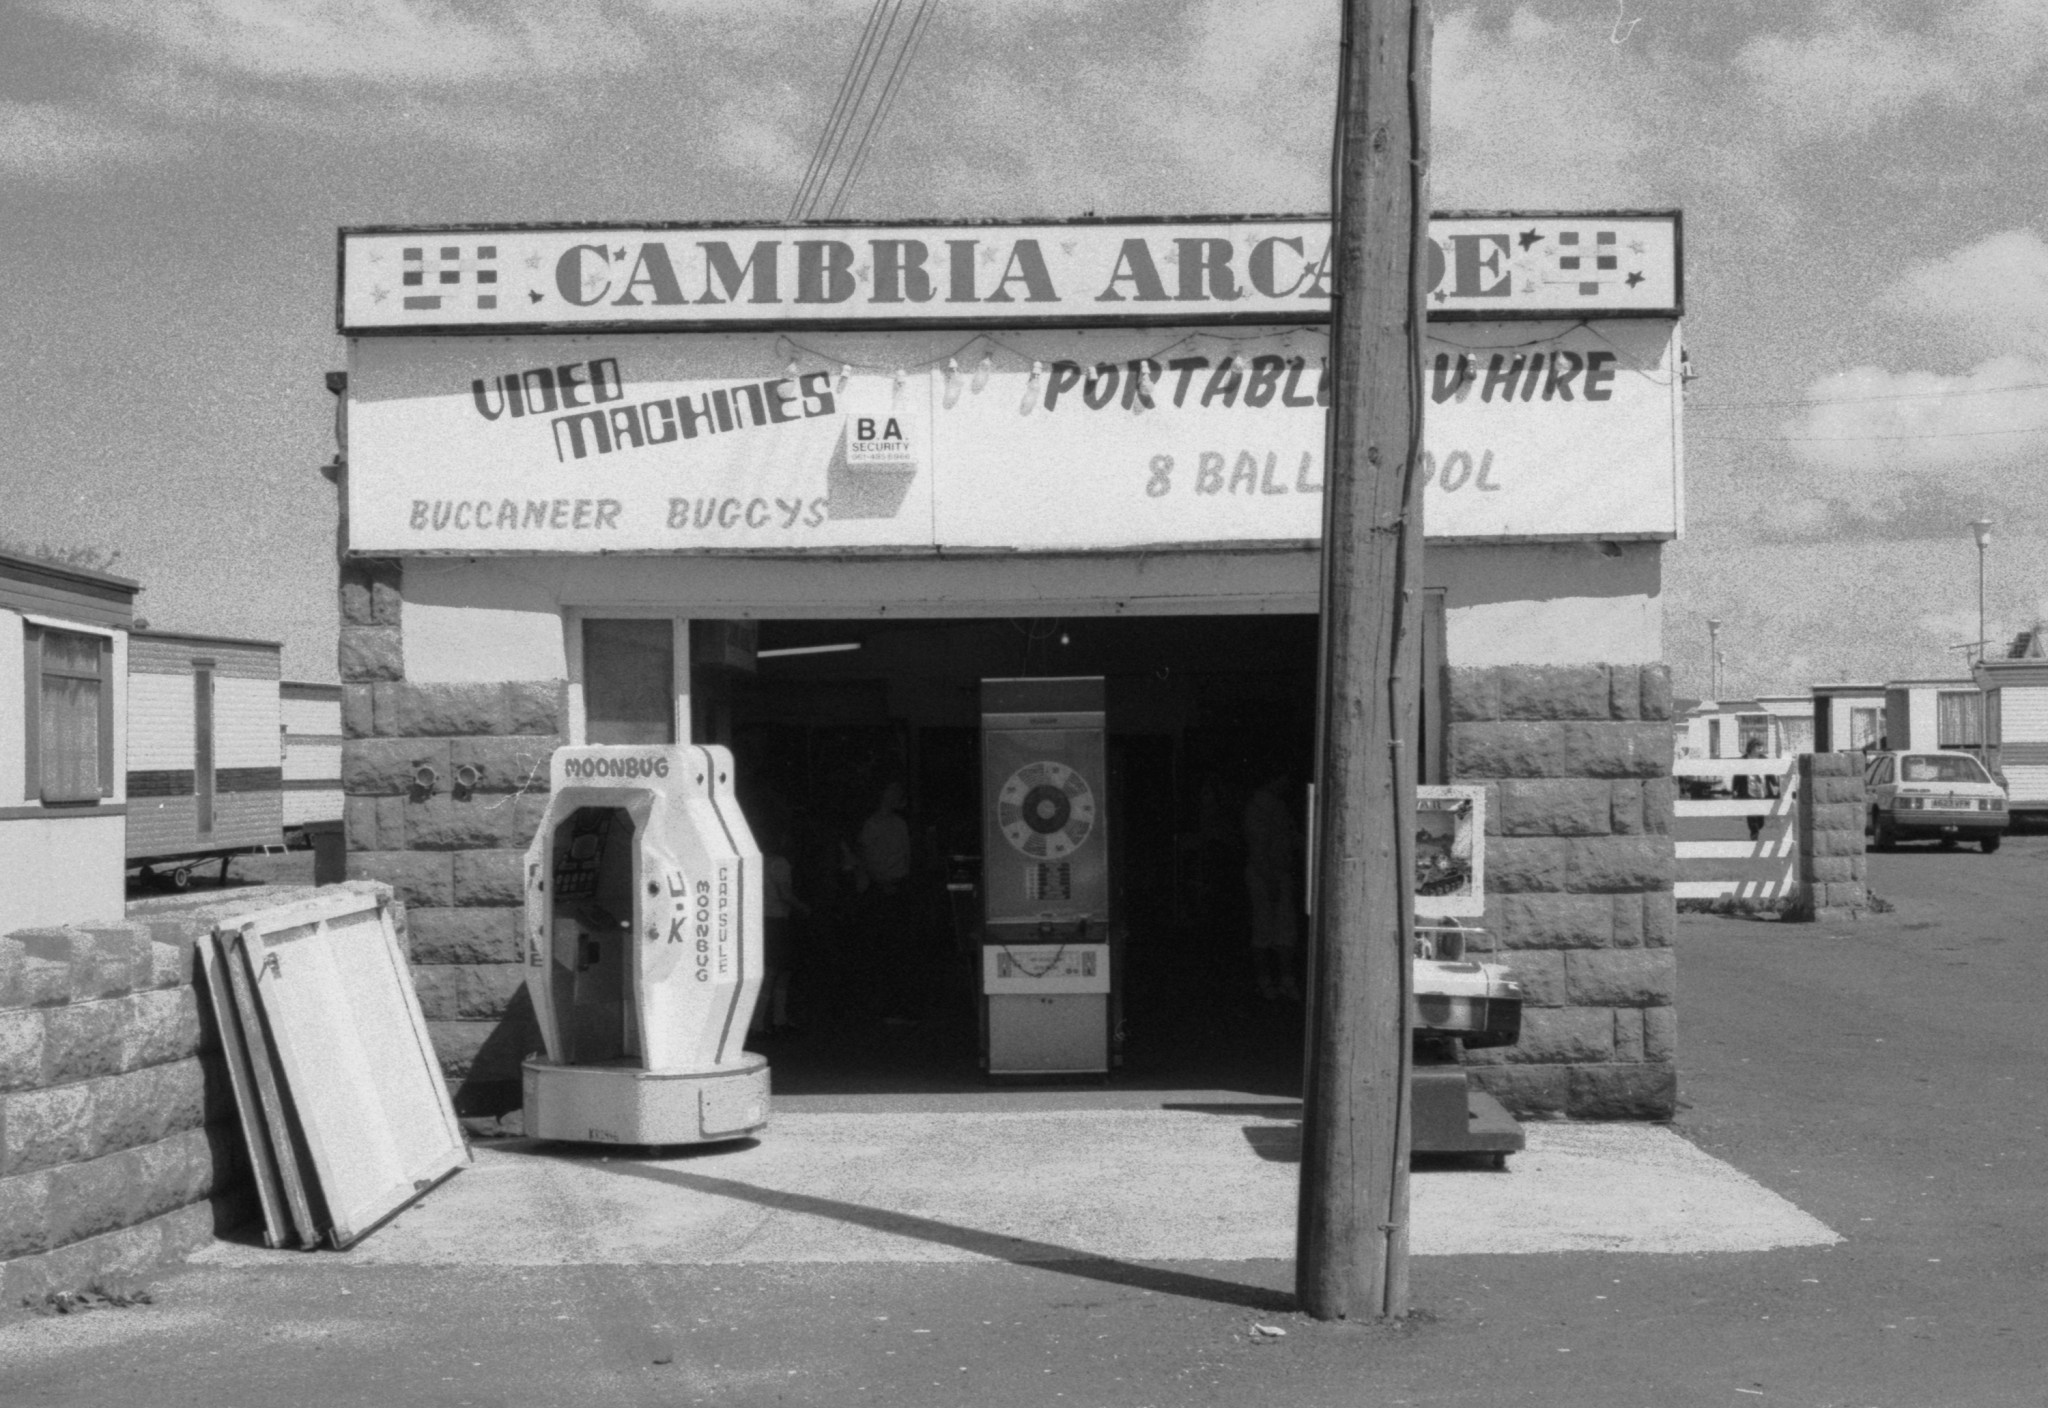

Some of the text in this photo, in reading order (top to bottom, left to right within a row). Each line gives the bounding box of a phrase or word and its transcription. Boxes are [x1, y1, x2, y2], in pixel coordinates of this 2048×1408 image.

[555, 239, 1062, 307] CAMBRIA
[472, 357, 624, 421] VIDEO
[1480, 350, 1618, 404] HIRE
[551, 371, 836, 463] MACHINES
[852, 442, 909, 452] SECURITY
[1145, 454, 1174, 498] 8
[1195, 450, 1323, 496] BALL
[409, 498, 622, 532] BUCCANEER
[565, 757, 669, 779] MOONBUG
[695, 880, 710, 982] MOONBUG
[719, 867, 728, 974] CAPSULE
